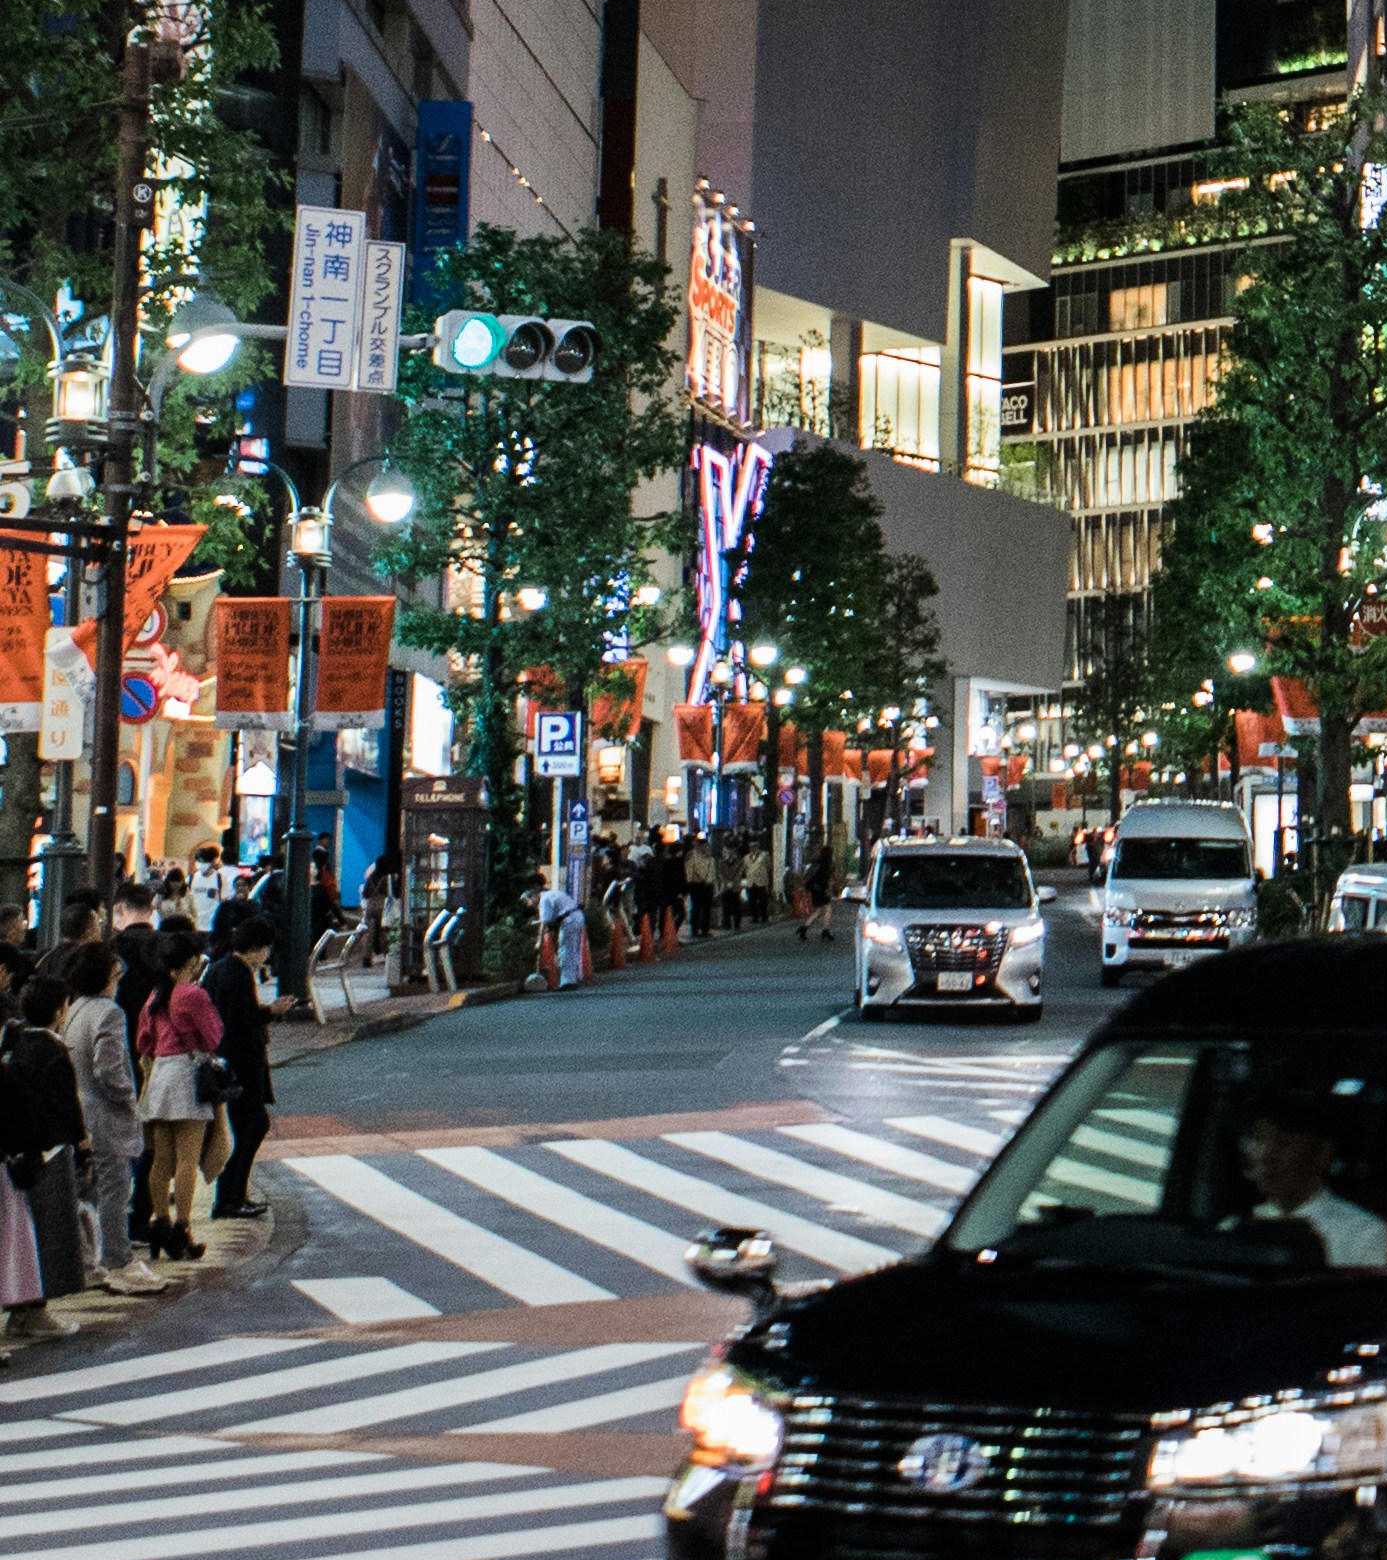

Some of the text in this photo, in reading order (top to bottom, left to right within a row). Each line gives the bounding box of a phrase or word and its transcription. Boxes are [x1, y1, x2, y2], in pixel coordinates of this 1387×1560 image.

[296, 224, 321, 370] Jin-nan 1-chome
[316, 219, 353, 378] 神南一丁目
[367, 248, 392, 385] スクランブル交差点
[691, 253, 740, 335] SPORTS
[393, 672, 405, 729] BOOKS
[541, 715, 570, 753] P
[414, 792, 466, 803] TELEPHONE
